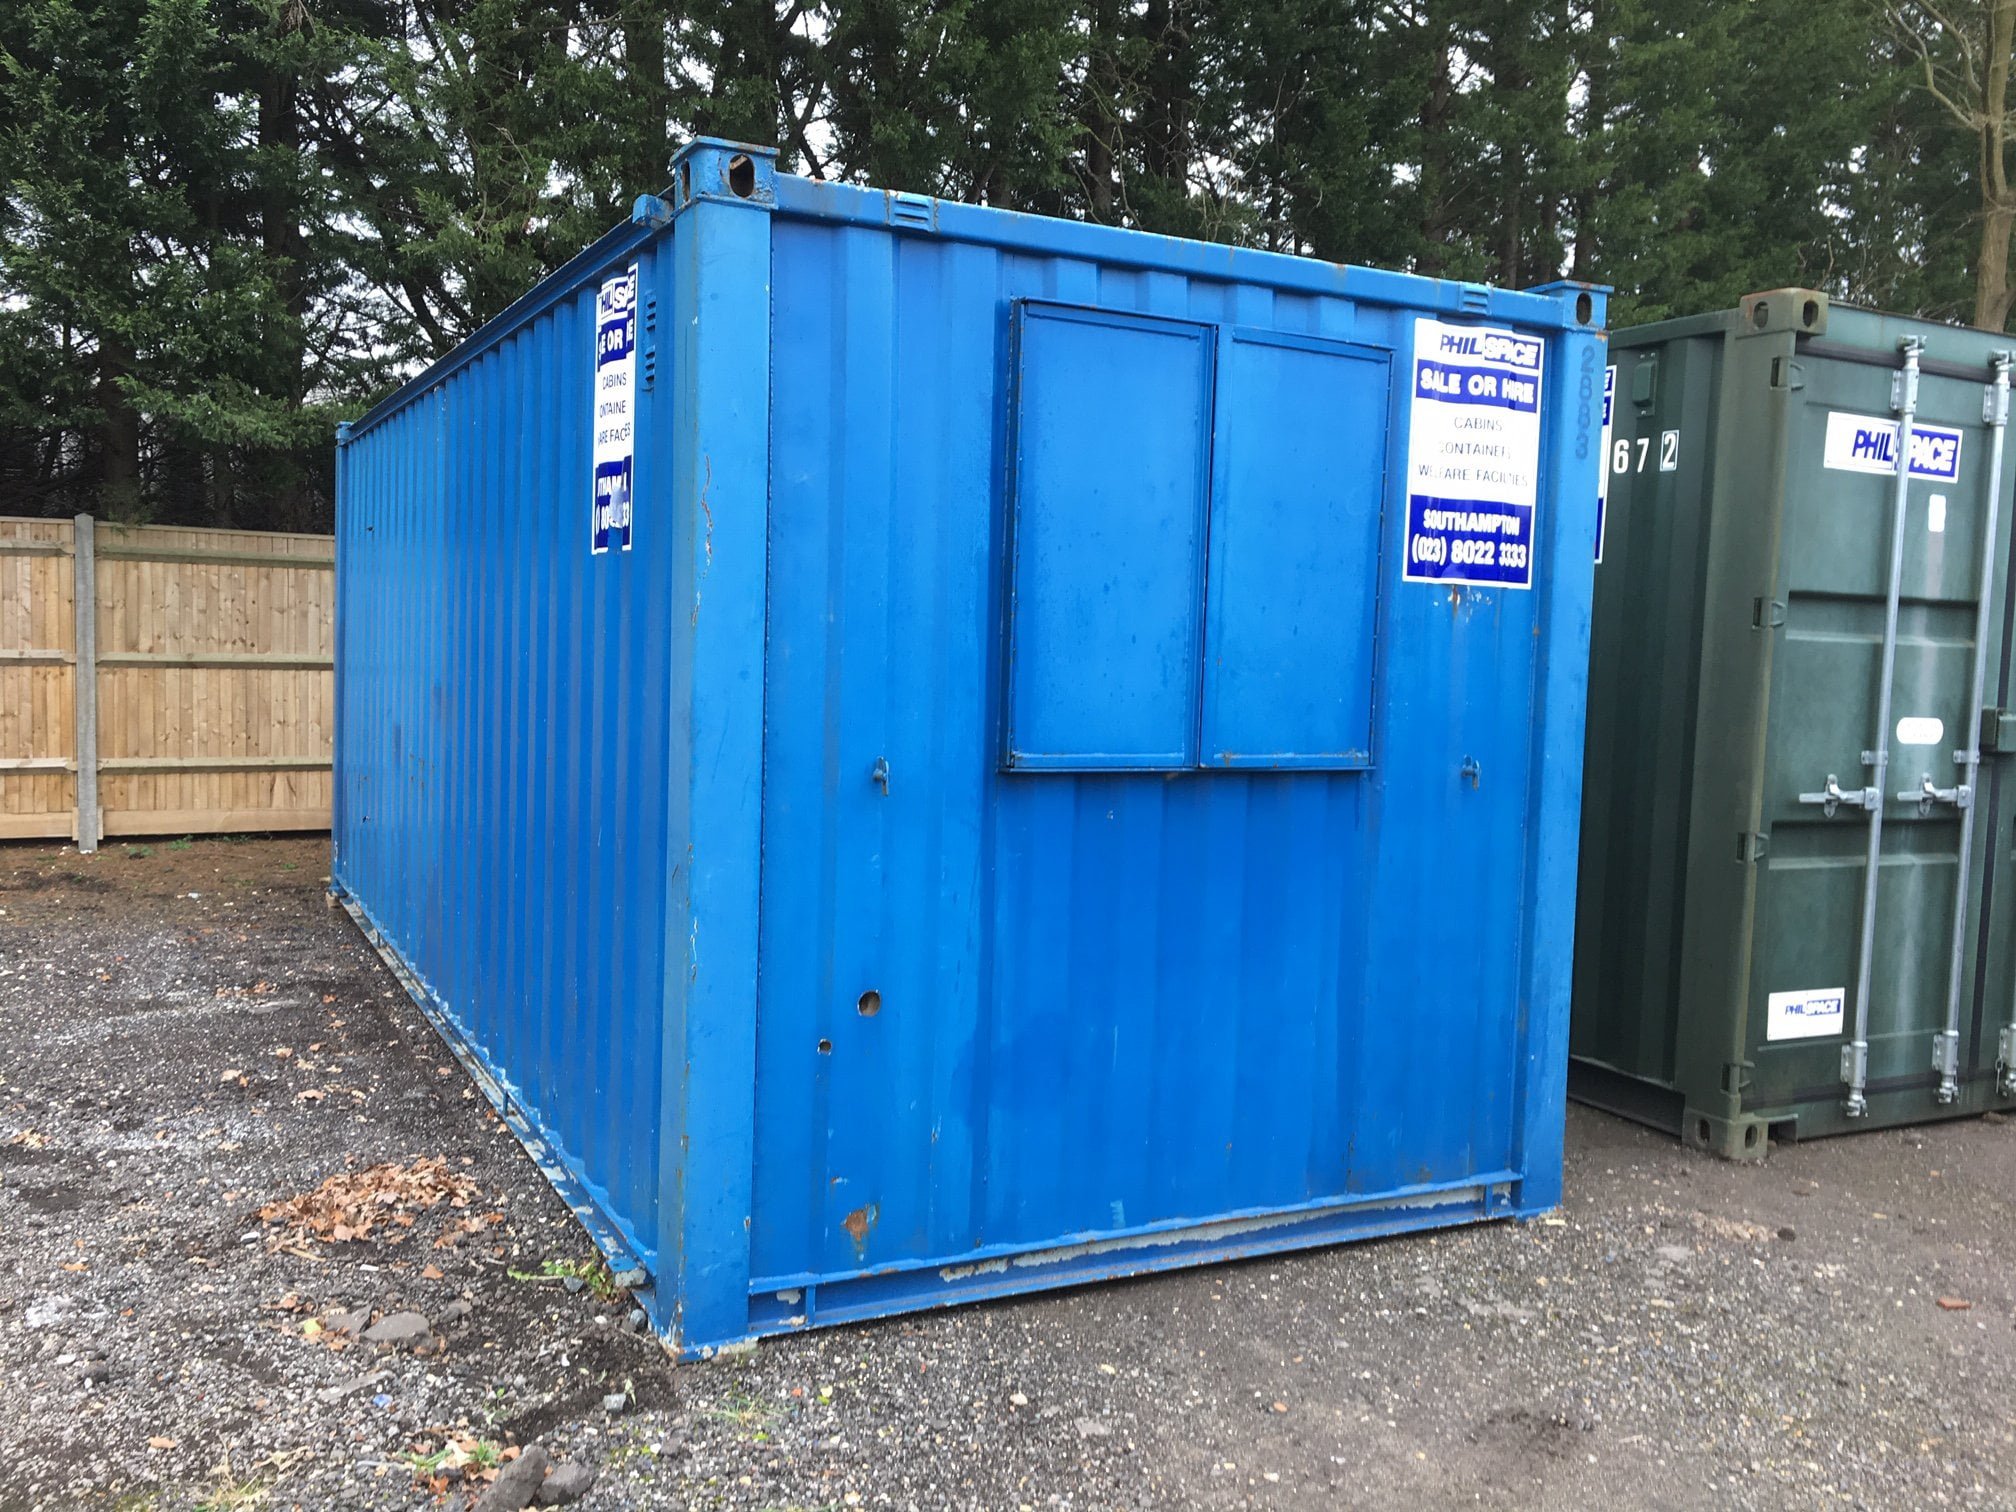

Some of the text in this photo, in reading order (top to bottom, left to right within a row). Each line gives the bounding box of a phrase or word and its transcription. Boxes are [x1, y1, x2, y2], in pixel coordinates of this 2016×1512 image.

[607, 328, 623, 352] OR
[603, 372, 627, 390] CABINS
[1420, 368, 1534, 403] SALE OR HIRE
[1454, 417, 1503, 431] CABINS
[1852, 429, 1956, 472] PHILPACE
[1423, 508, 1520, 536] SOUTHAMPTON
[1412, 533, 1527, 568] (023) 8022 3333
